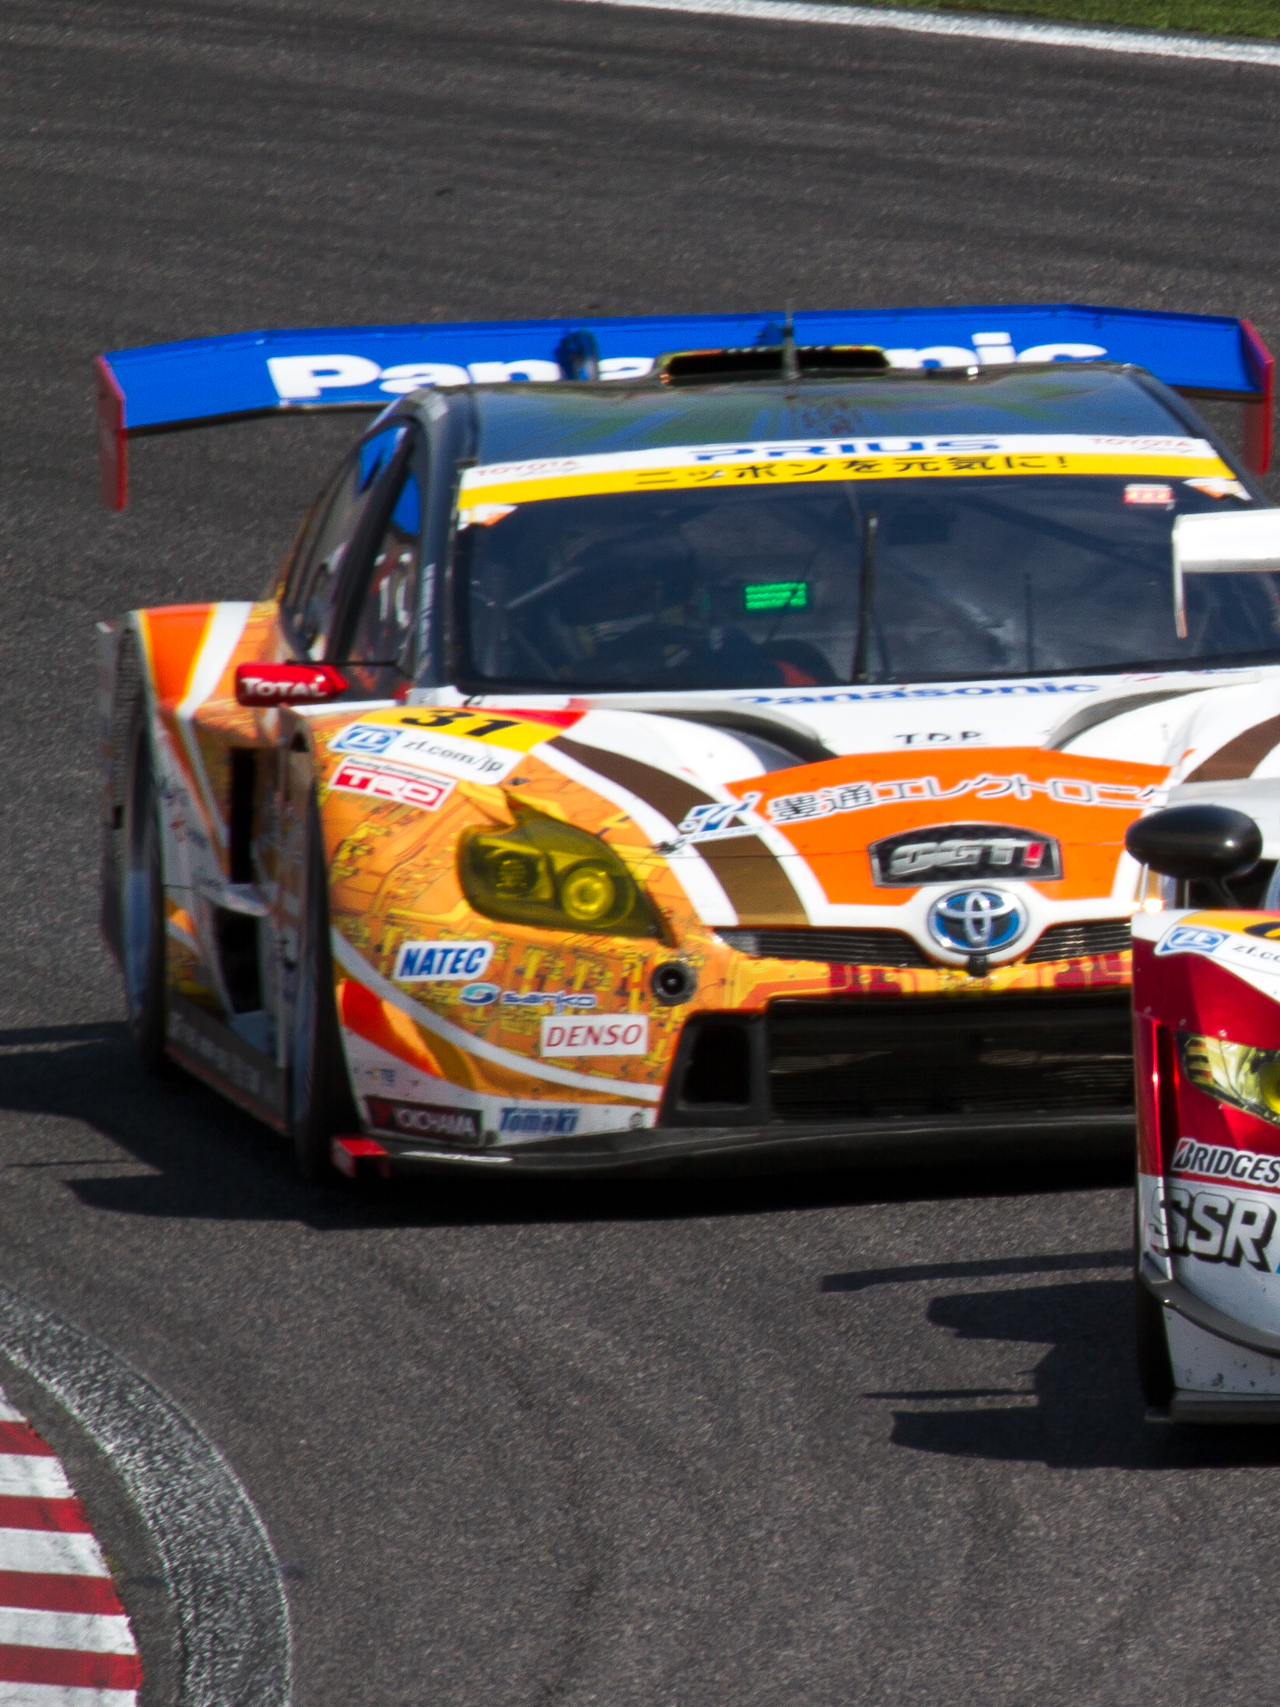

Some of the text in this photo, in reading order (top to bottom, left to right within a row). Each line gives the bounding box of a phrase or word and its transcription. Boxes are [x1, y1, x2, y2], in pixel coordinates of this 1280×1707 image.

[689, 439, 1000, 461] PRIUS
[240, 676, 328, 697] TOTAL
[399, 709, 522, 737] 31
[400, 948, 486, 977] NATEC
[546, 1024, 642, 1047] DENSO
[1149, 1186, 1277, 1273] SSR
